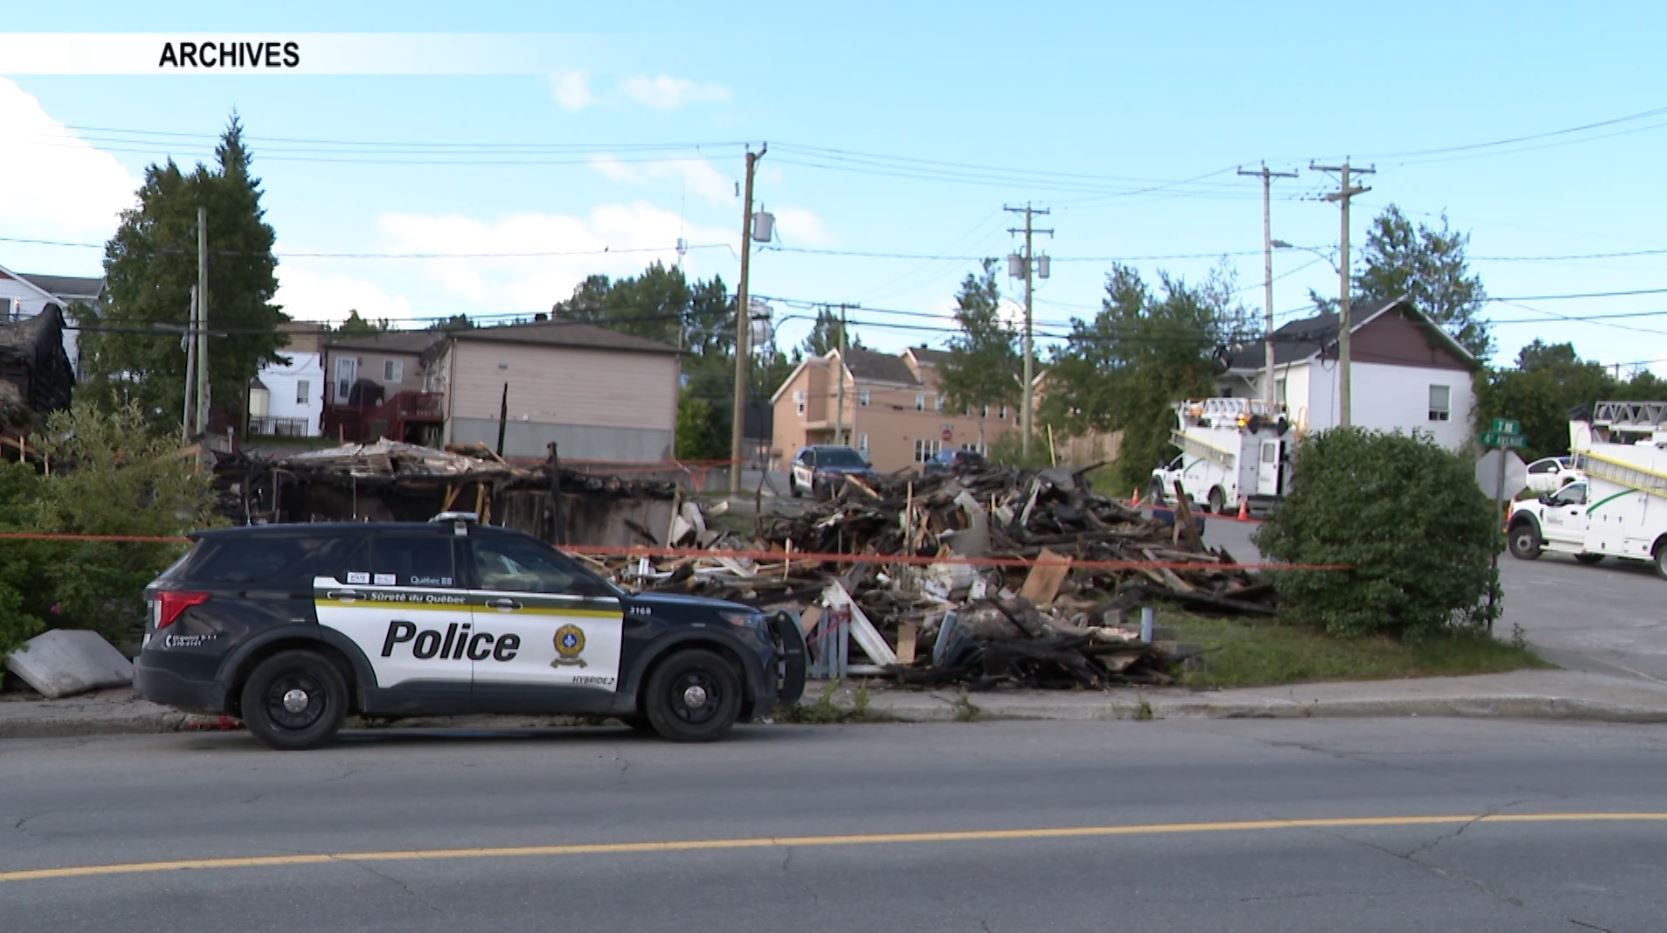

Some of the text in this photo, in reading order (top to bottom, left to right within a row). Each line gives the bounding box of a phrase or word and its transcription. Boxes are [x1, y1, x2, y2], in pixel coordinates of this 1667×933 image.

[371, 591, 465, 605] Sûreté du Québec
[381, 619, 521, 662] Police
